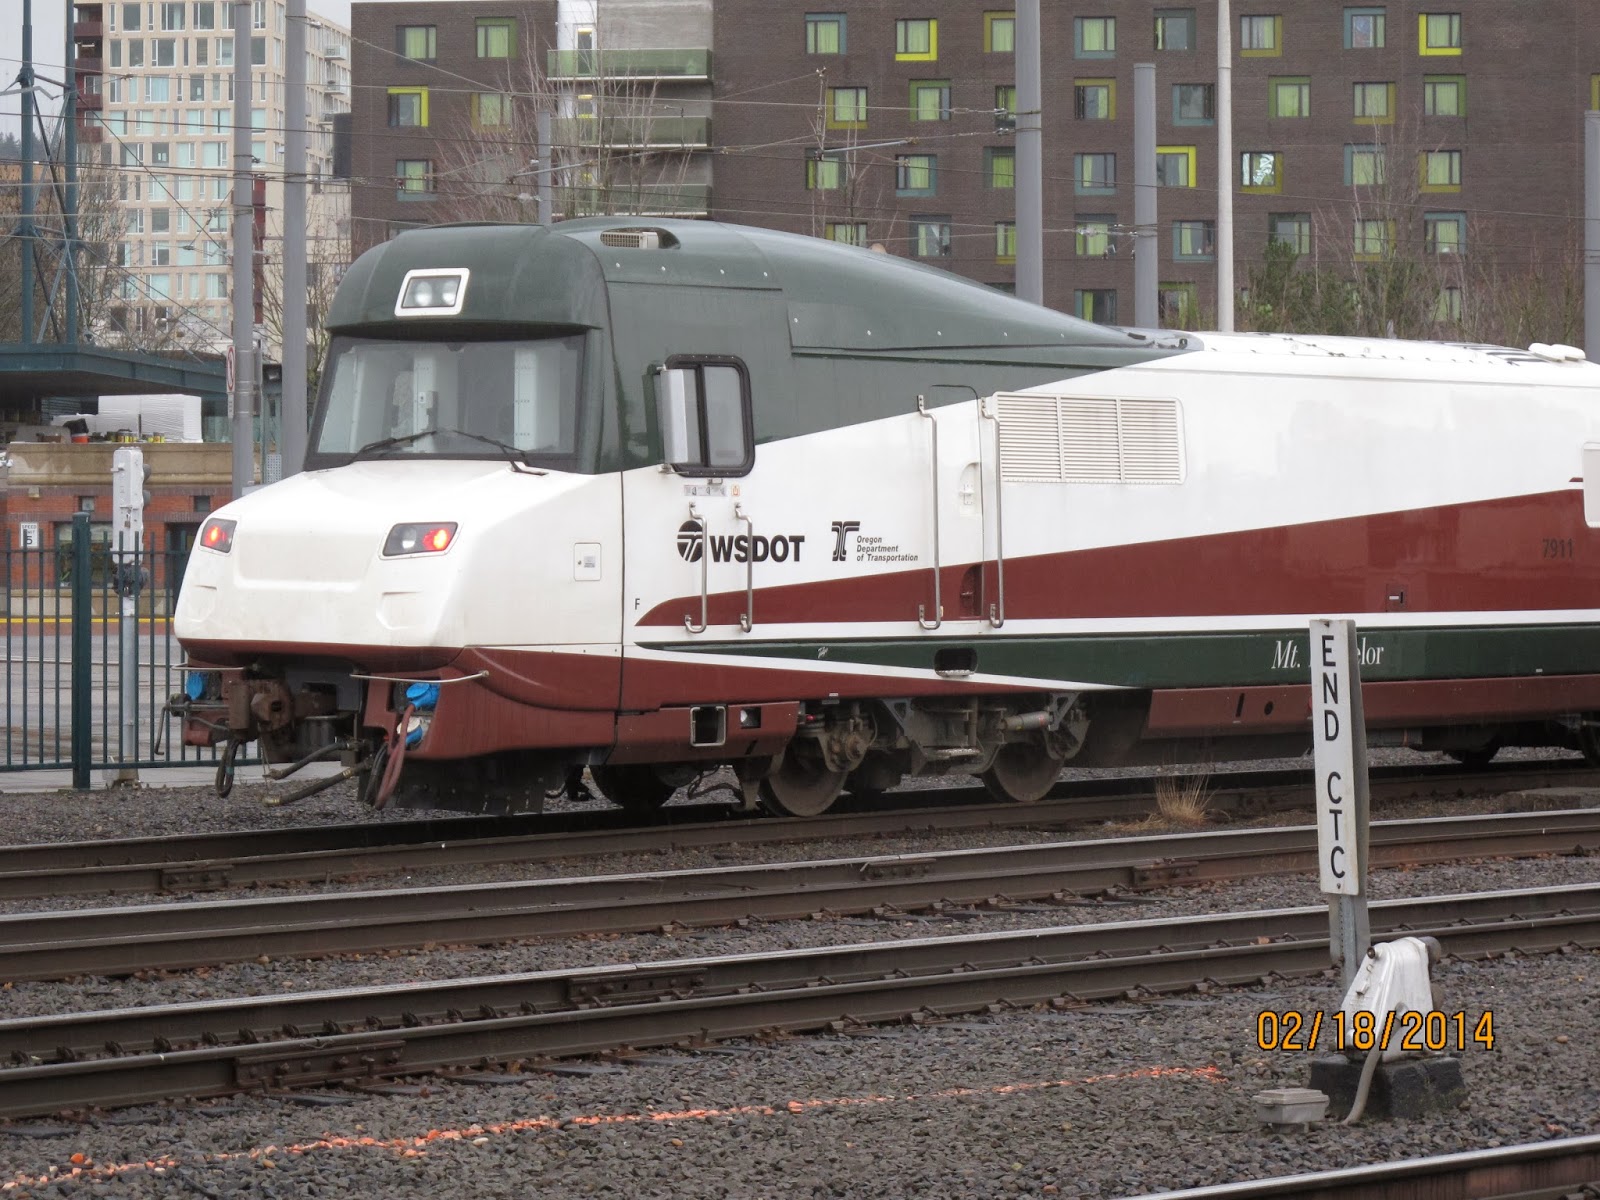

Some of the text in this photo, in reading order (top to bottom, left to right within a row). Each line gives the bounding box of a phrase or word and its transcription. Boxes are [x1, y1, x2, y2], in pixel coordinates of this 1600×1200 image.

[710, 535, 805, 562] WSDOT
[856, 535, 882, 545] Oregon
[856, 544, 899, 553] Department
[1542, 538, 1574, 559] 7911
[856, 553, 919, 563] of Transportation
[1271, 639, 1301, 669] Mt.
[1321, 635, 1346, 879] END CTC
